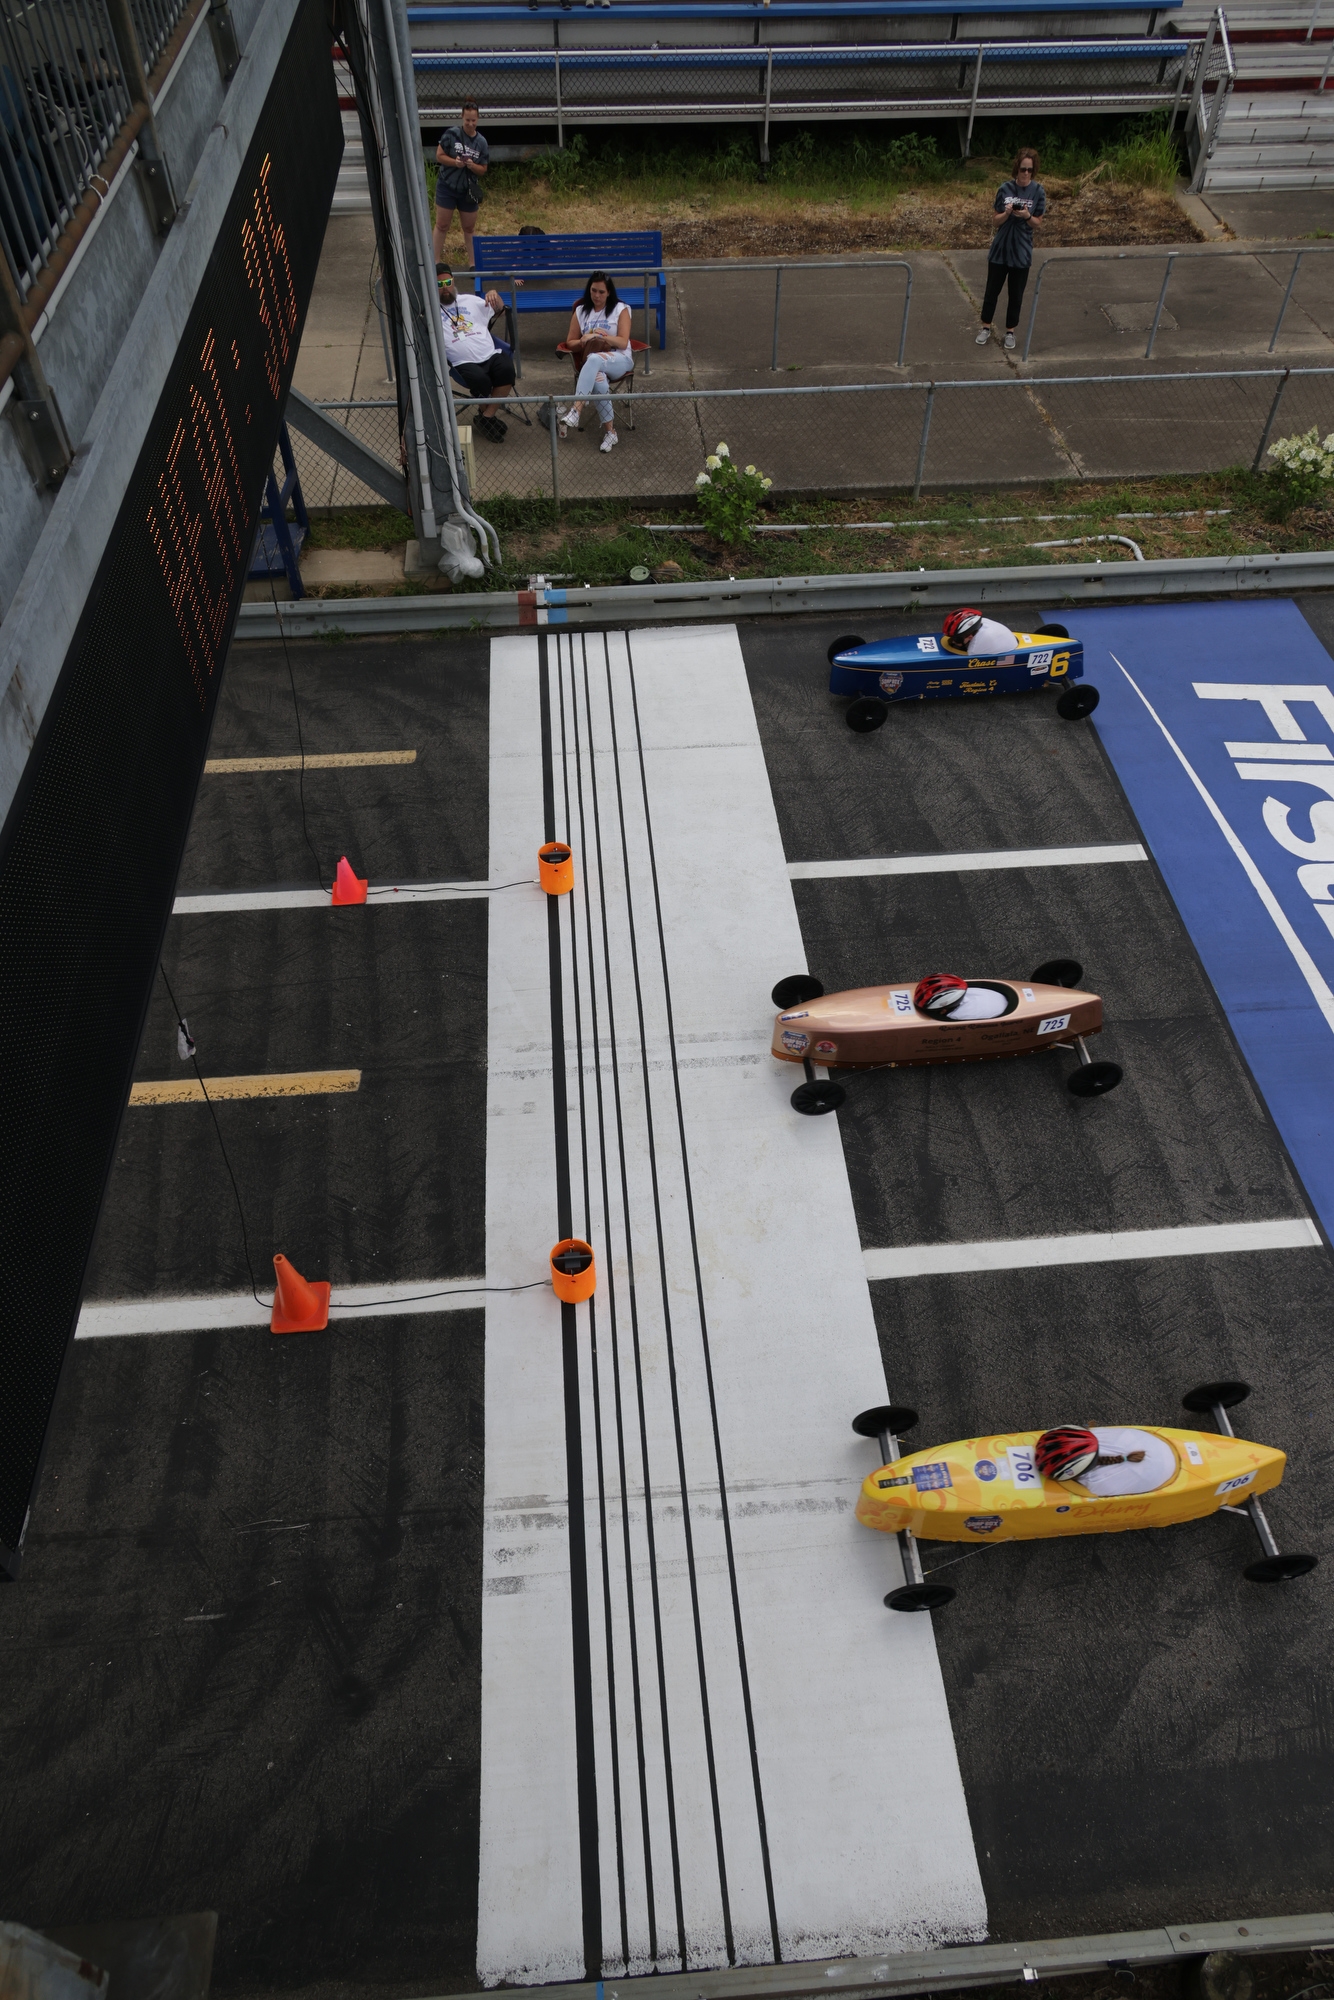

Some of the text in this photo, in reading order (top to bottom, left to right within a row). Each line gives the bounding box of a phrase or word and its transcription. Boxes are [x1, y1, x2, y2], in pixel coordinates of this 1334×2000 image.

[241, 152, 297, 400] 315
[922, 639, 935, 650] 722
[968, 658, 996, 668] Chase
[1031, 653, 1049, 665] 722
[1050, 651, 1071, 677] 6
[894, 993, 912, 1011] 725
[1043, 1017, 1065, 1032] 725
[921, 1037, 954, 1045] Region
[1012, 1452, 1035, 1482] 706
[1222, 1475, 1250, 1492] 706
